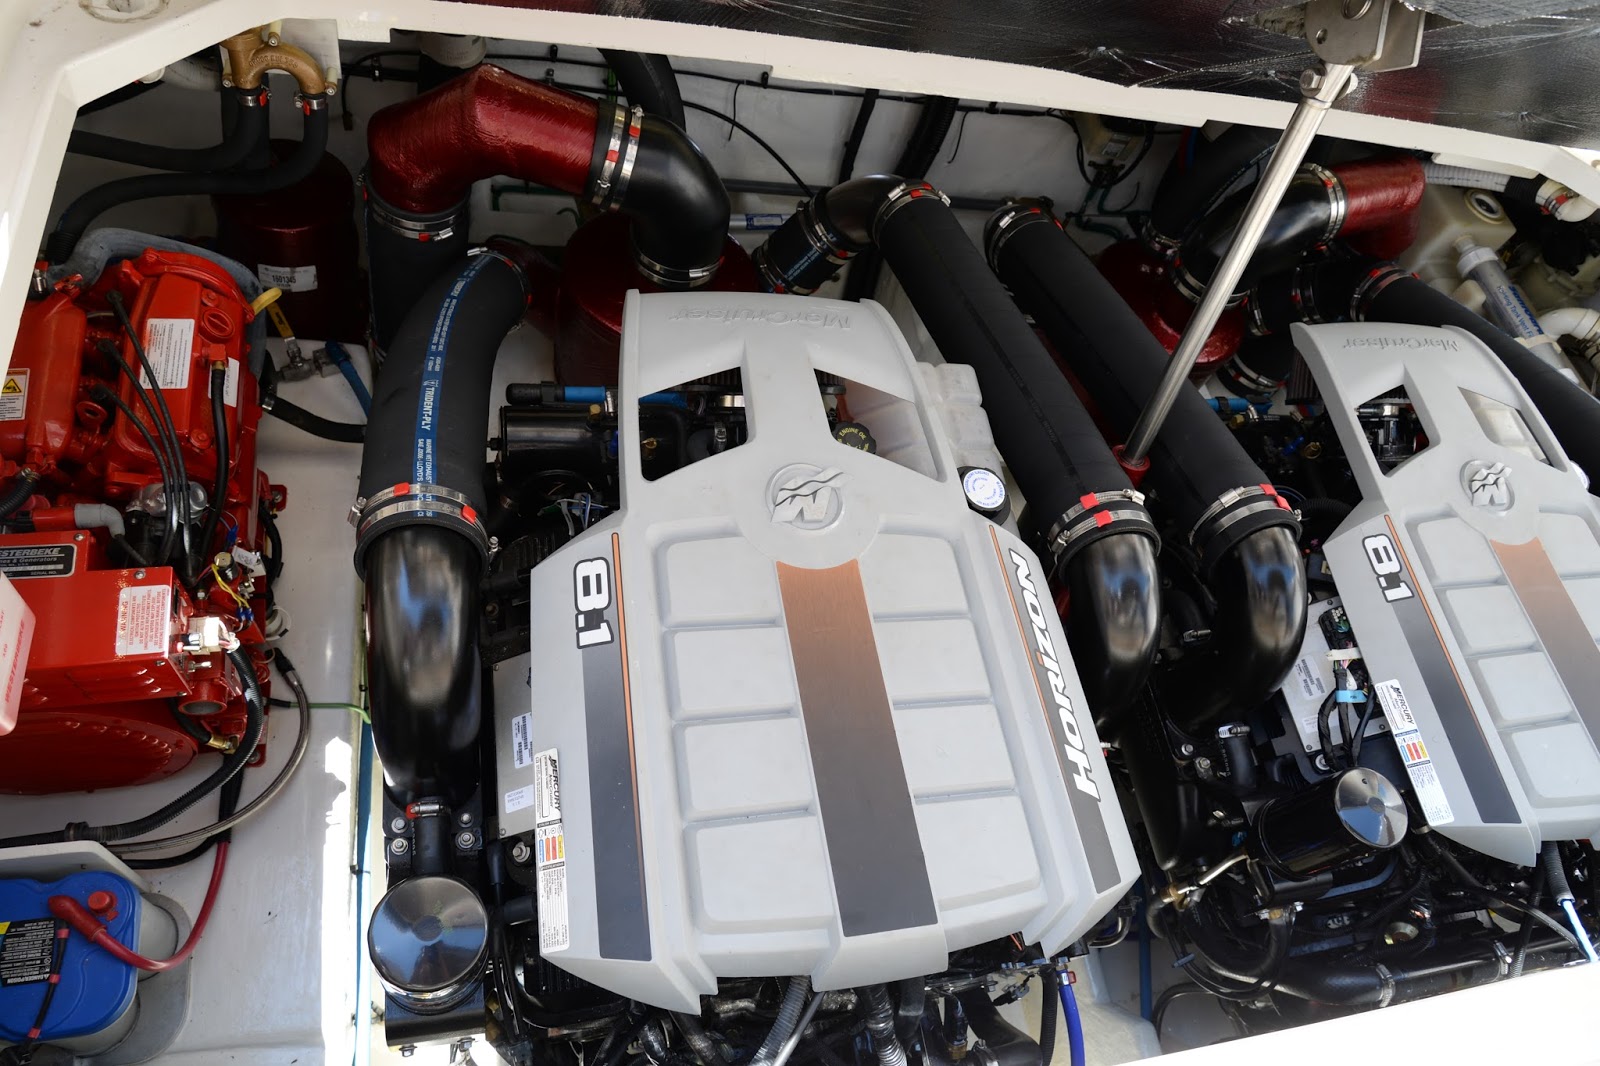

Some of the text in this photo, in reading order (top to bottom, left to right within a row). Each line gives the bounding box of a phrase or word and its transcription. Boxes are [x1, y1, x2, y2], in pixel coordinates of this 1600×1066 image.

[1511, 306, 1521, 318] Tank
[1518, 318, 1529, 331] Vent
[421, 387, 434, 430] TRIDENT-PLY
[839, 428, 858, 436] ENGINE
[0, 548, 61, 556] STERBEKE
[1362, 534, 1414, 602] 8.1
[120, 601, 128, 631] WARNING
[574, 556, 614, 649] 8.1
[5, 620, 25, 702] WESTERBEKE
[1389, 685, 1414, 724] MERCURY
[548, 755, 560, 812] MERCURY
